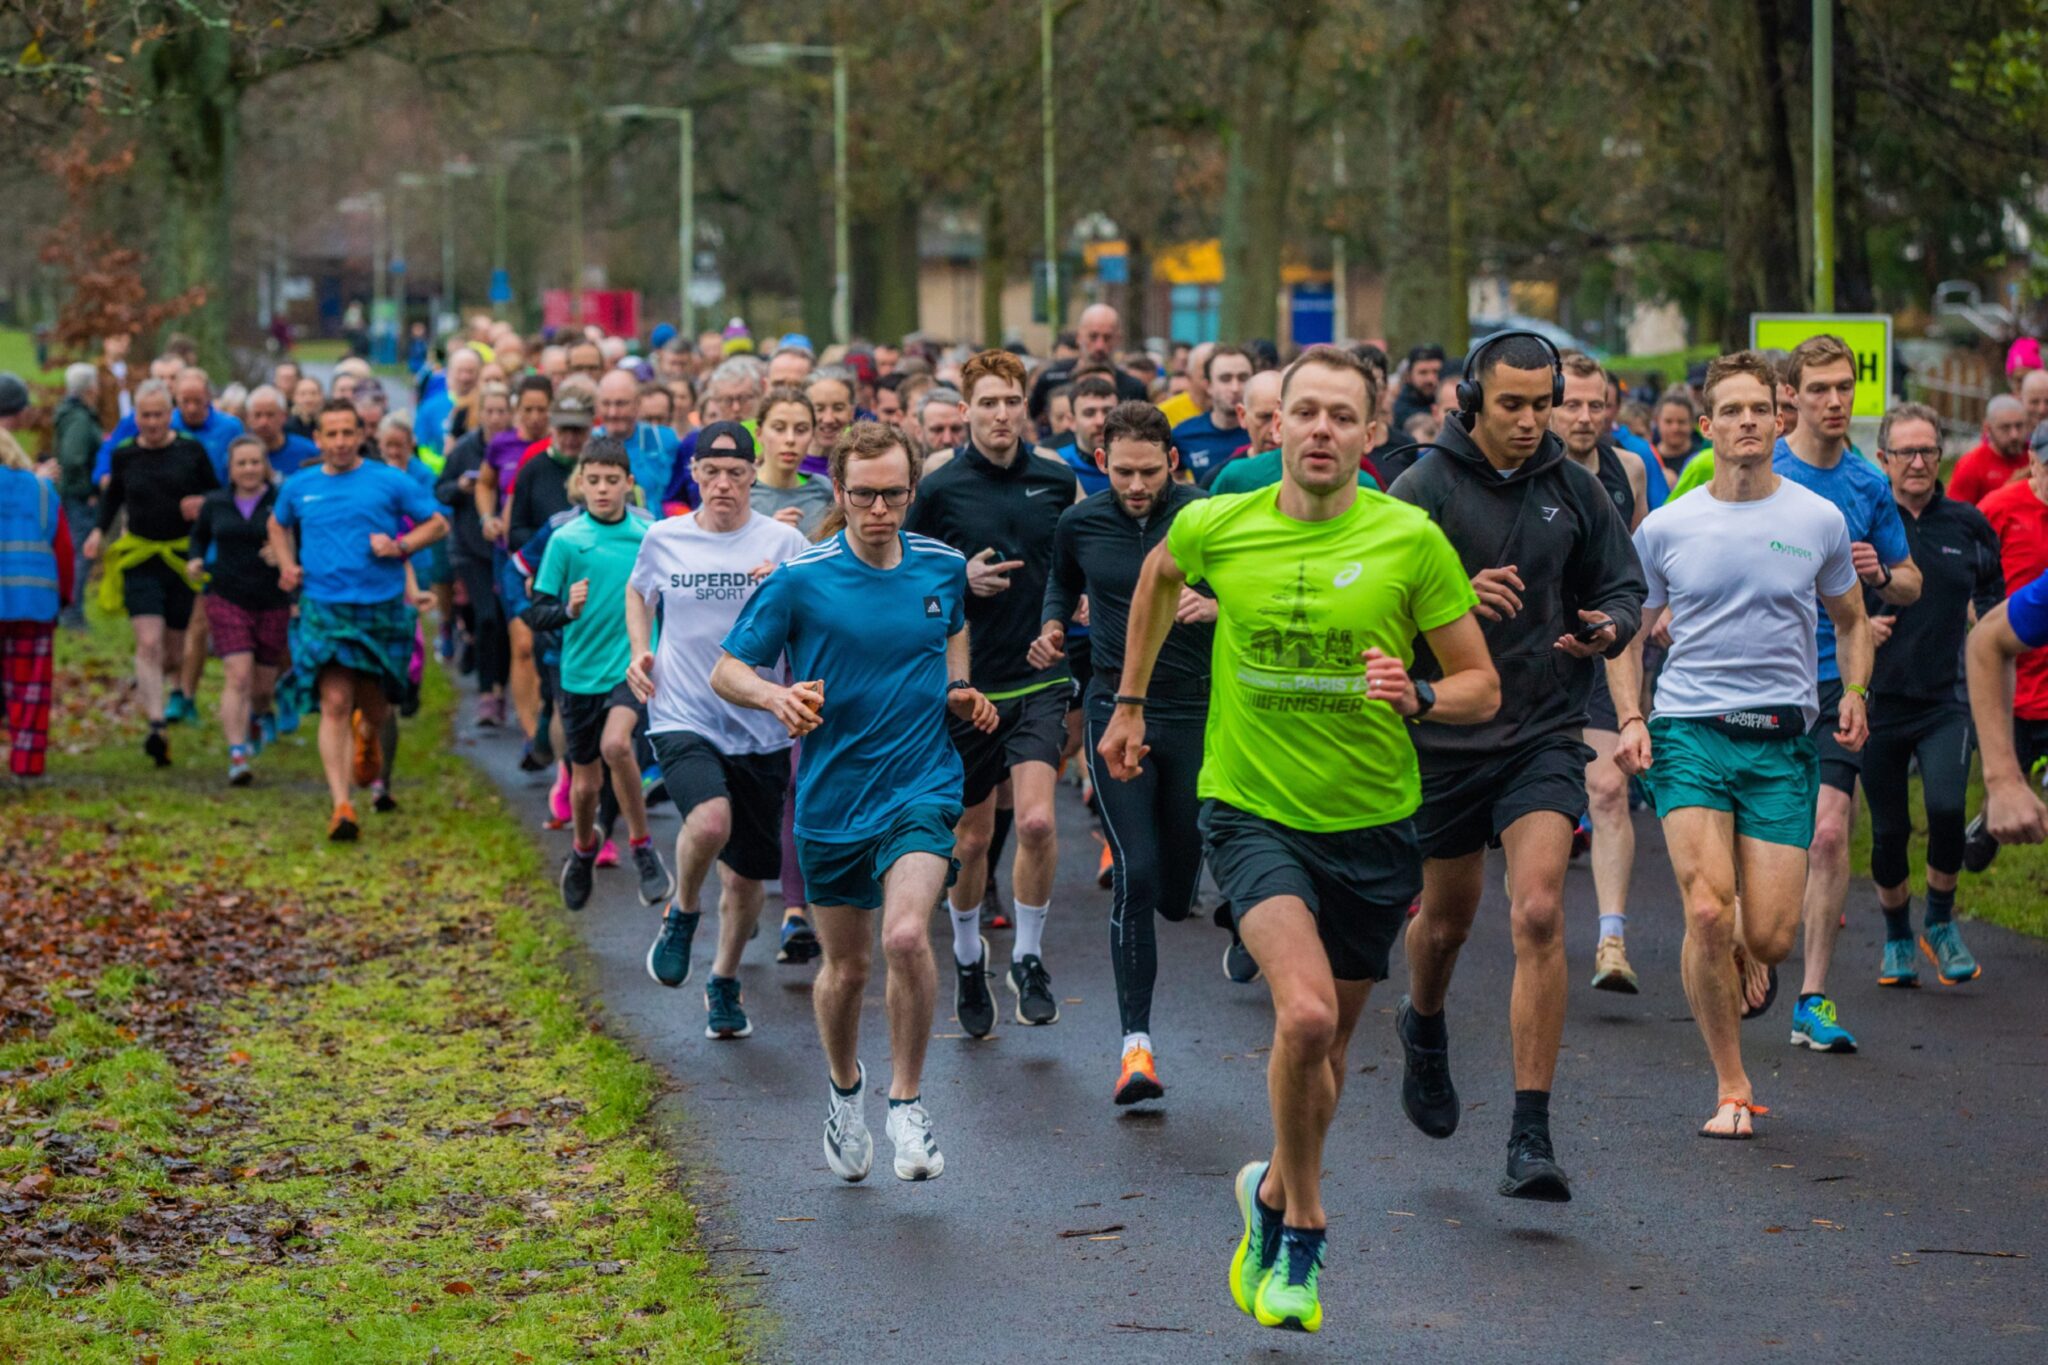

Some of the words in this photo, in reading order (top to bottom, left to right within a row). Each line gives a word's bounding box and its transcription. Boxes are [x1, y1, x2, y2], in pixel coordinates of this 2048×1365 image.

[671, 573, 765, 588] SUPERDR
[695, 588, 746, 600] SPORT
[1294, 675, 1347, 693] PARIS
[1266, 695, 1365, 714] FINISHER
